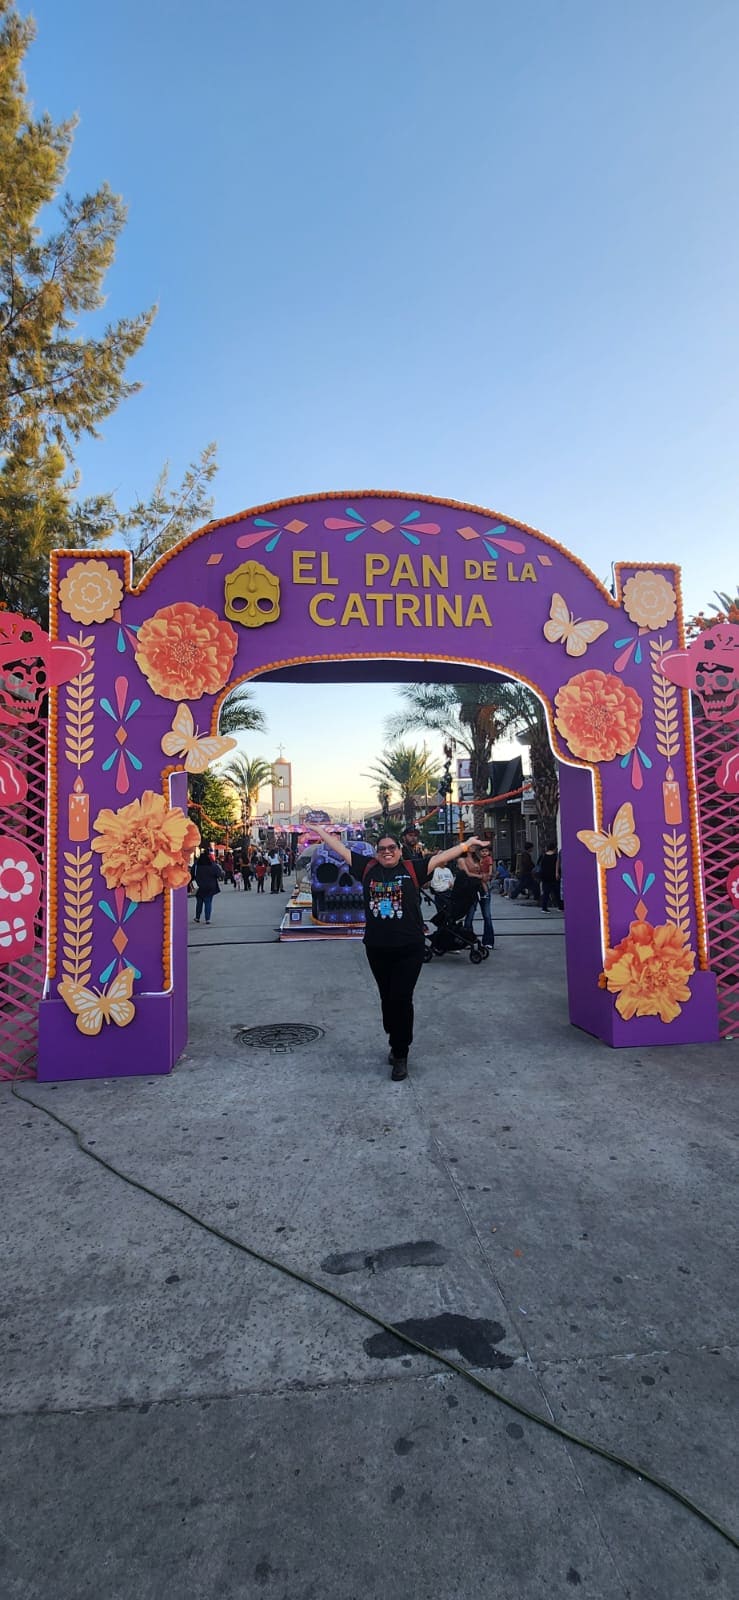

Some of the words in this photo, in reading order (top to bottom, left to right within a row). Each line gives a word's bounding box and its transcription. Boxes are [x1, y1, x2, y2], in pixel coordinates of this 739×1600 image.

[292, 550, 339, 585] EL
[365, 553, 449, 588] PAN
[464, 559, 498, 581] DE
[507, 561, 538, 582] LA
[308, 592, 493, 627] CATRINA
